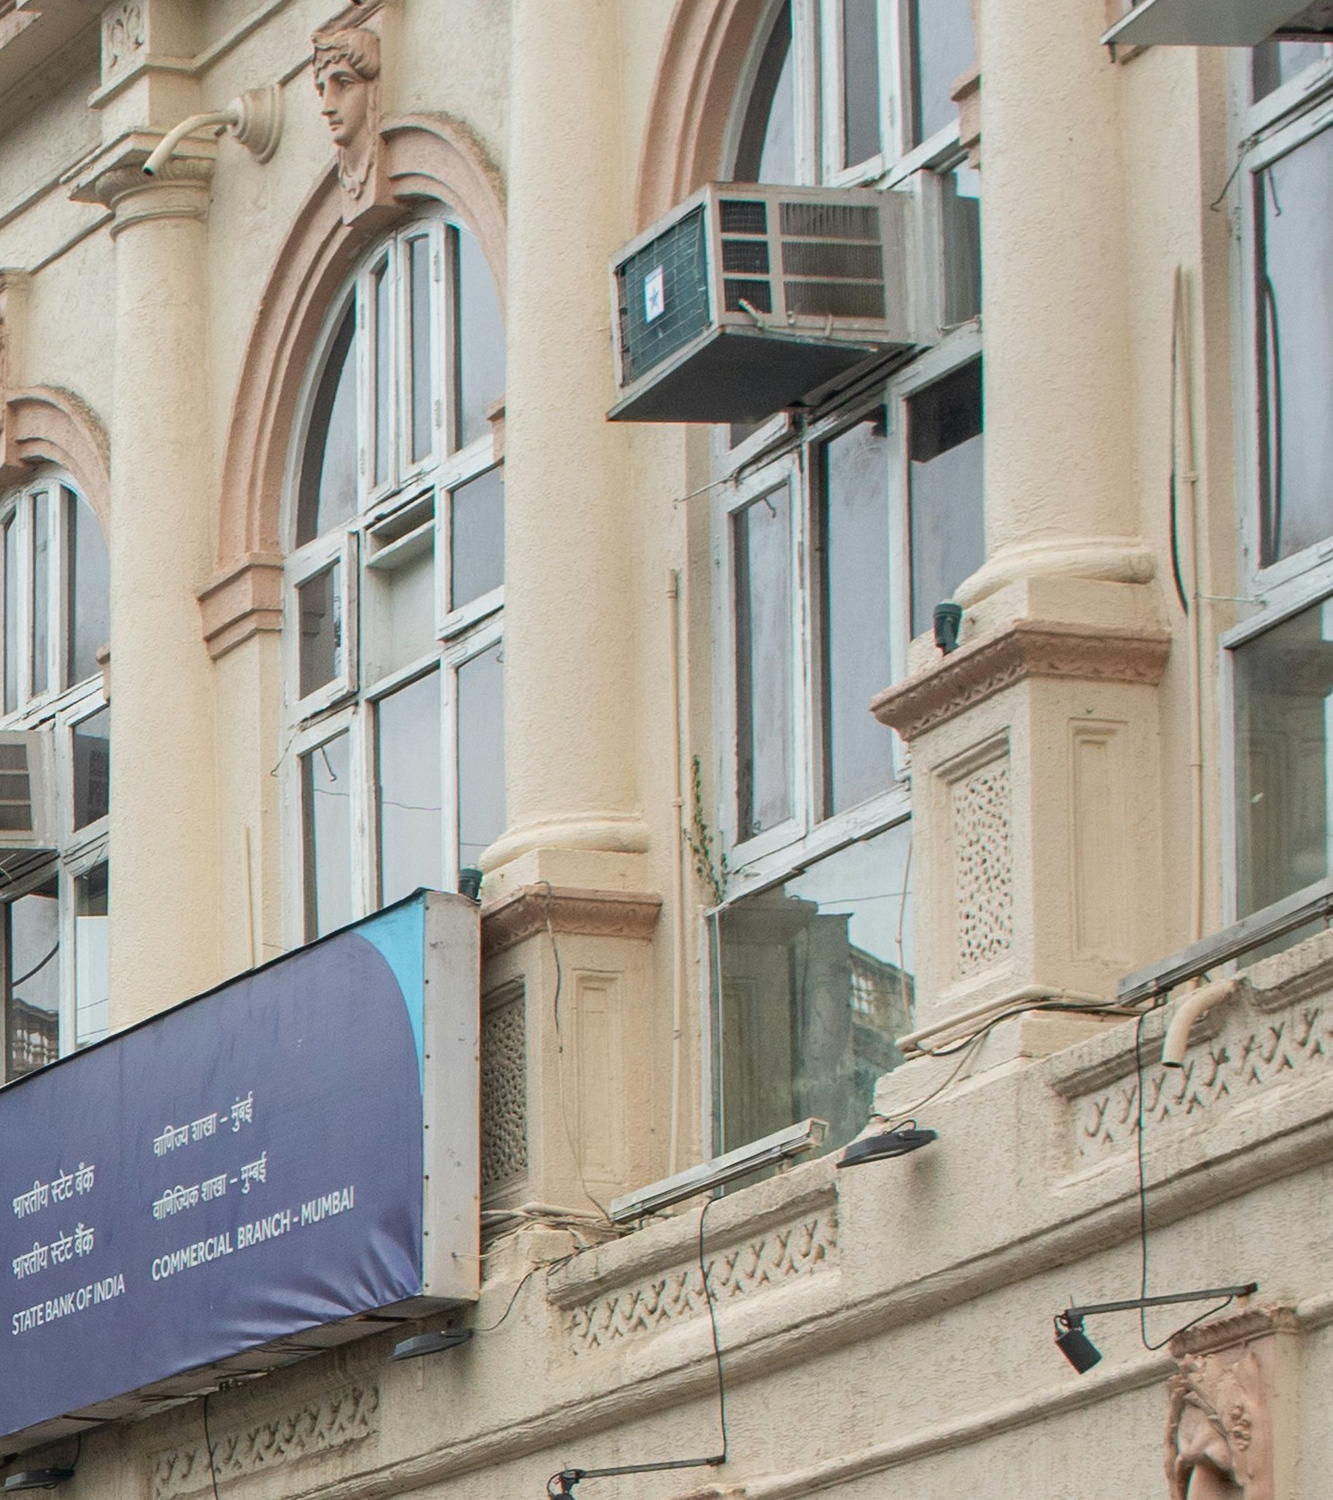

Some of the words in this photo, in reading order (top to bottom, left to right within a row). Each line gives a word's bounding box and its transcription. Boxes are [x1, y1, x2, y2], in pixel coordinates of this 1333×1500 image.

[153, 1125, 190, 1157] वाणिज्य
[191, 1112, 217, 1141] शाखा
[231, 1090, 253, 1132] मुंबई
[13, 1180, 49, 1219] भारतीय
[51, 1169, 73, 1203] स्टेट
[75, 1161, 95, 1195] बँक
[152, 1185, 199, 1220] वाणिज्यिक
[201, 1173, 227, 1201] शाखा
[241, 1150, 267, 1194] मुम्बई
[12, 1242, 49, 1280] भारतीय
[50, 1231, 73, 1265] स्टेट
[74, 1222, 95, 1257] बैंक
[151, 1232, 233, 1281] COMMERCIAL
[237, 1209, 291, 1250] BRANCH
[301, 1185, 355, 1226] MUMBAI
[12, 1303, 44, 1335] STATE
[45, 1291, 76, 1322] BANK
[76, 1285, 93, 1311] OF
[94, 1273, 126, 1304] INDIA
